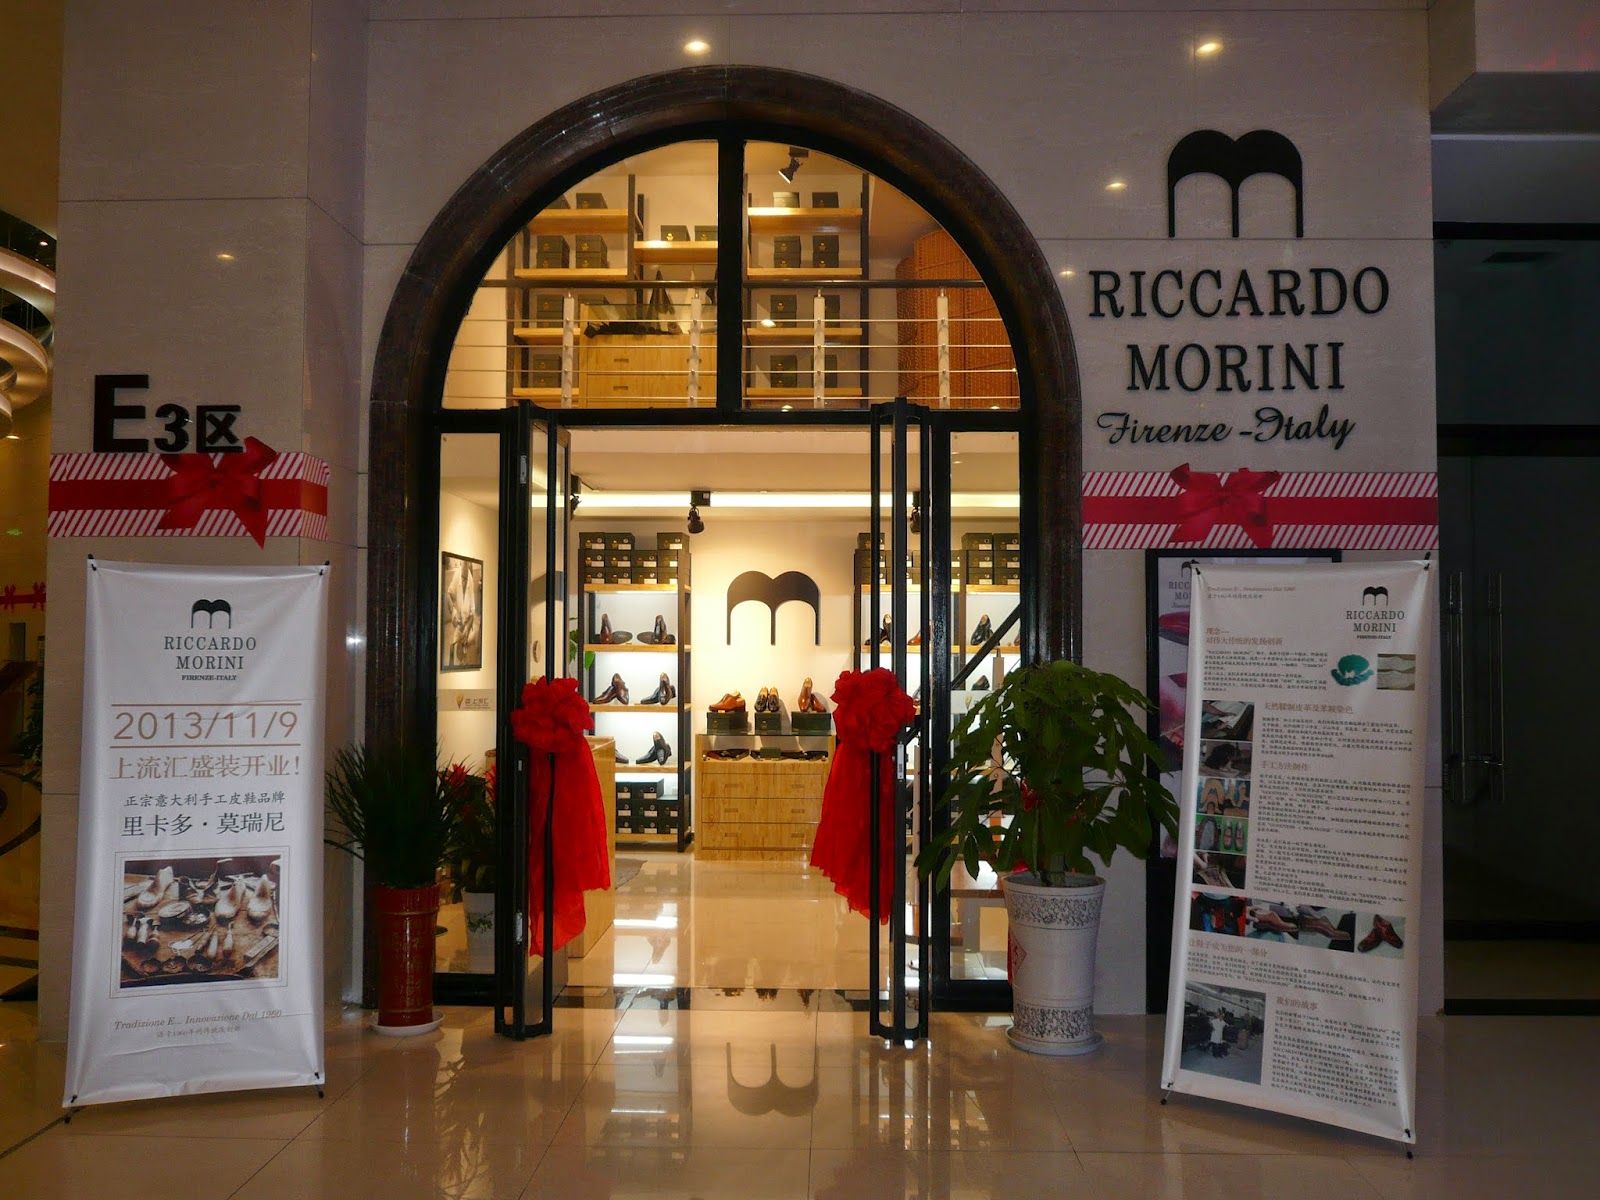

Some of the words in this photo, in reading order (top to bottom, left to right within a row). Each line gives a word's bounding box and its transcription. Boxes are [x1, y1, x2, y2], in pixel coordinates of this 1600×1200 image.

[1088, 266, 1390, 318] RICCARDO
[1126, 341, 1345, 392] MORINI
[1096, 410, 1233, 445] Firenze
[1345, 610, 1405, 620] RICCARDO
[1353, 622, 1397, 632] MORINI
[164, 636, 257, 651] RICCARDO
[175, 655, 244, 670] MORINI
[113, 711, 298, 740] 2013/11/9
[123, 792, 286, 808] 正宗意大利手工皮鞋品牌
[114, 1019, 165, 1030] Tradizione
[185, 1013, 240, 1025] Innovazione
